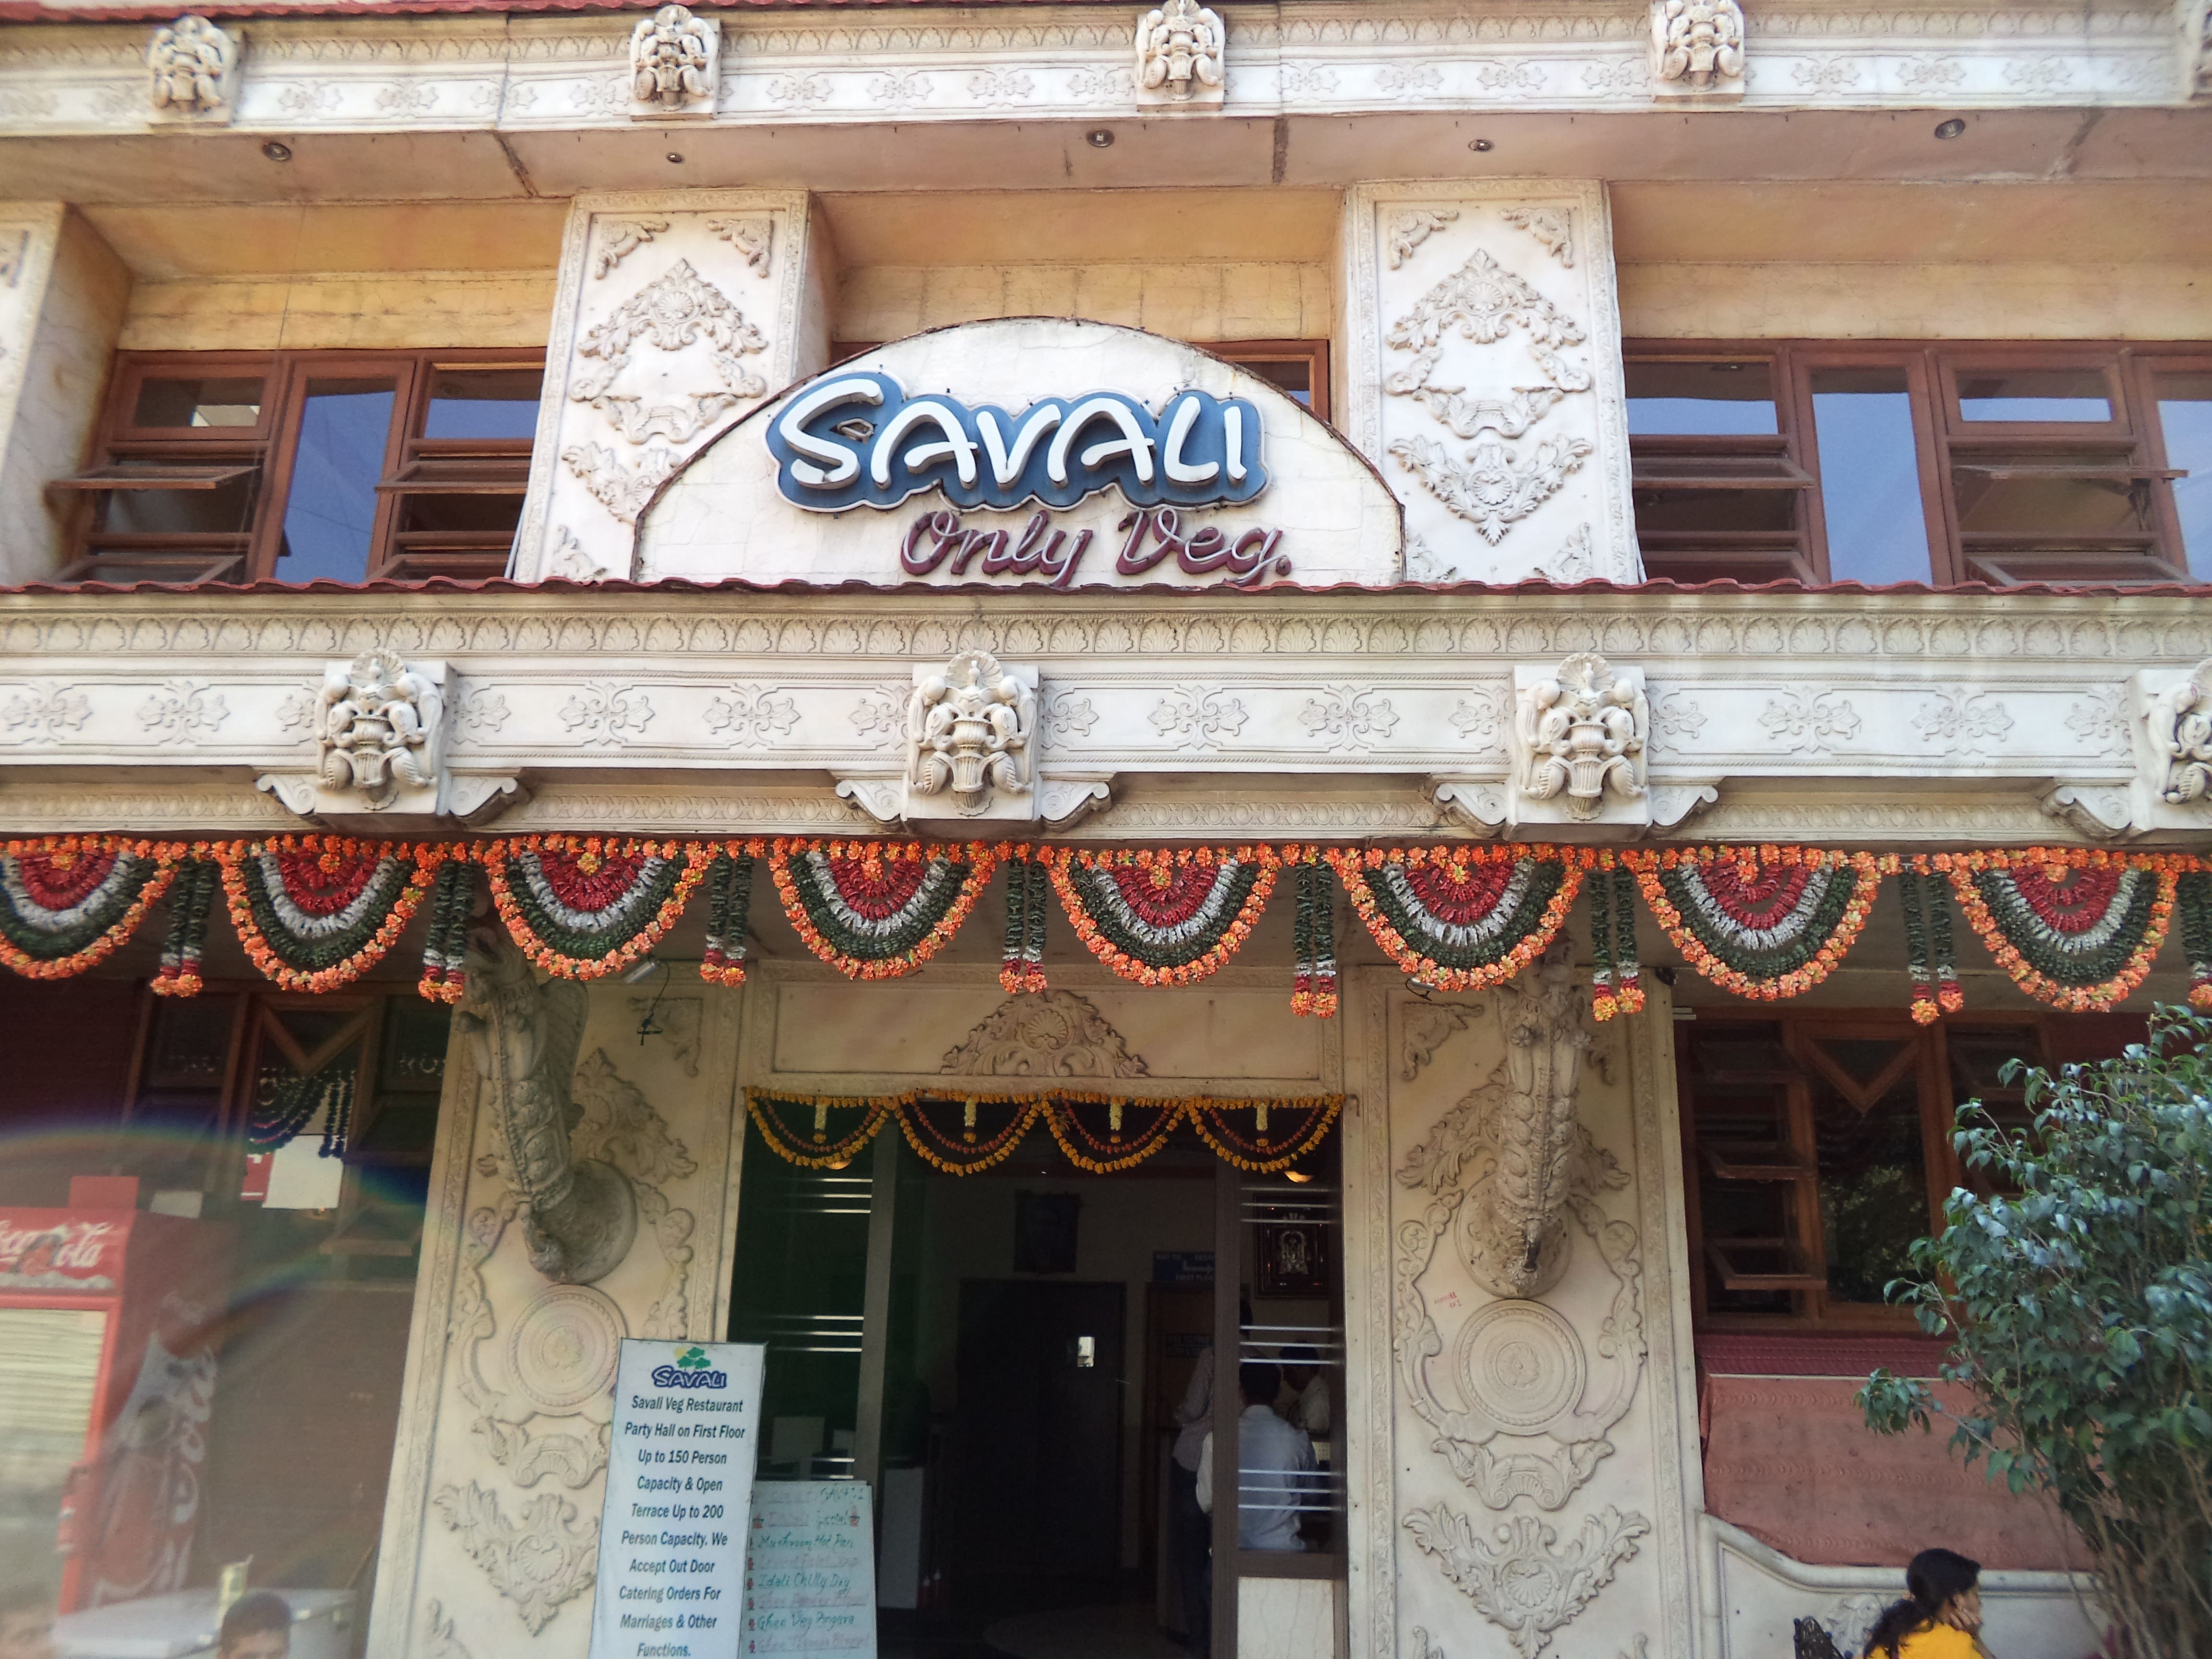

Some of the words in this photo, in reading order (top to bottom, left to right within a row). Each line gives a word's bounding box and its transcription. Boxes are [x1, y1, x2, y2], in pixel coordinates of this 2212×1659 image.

[778, 377, 1249, 491] SAVALI
[901, 509, 1094, 588] Only
[651, 1364, 727, 1389] SAVALI
[666, 1397, 685, 1413] Veg
[686, 1397, 744, 1412] Restaurant
[625, 1421, 652, 1439] Party
[655, 1422, 676, 1437] Hall
[678, 1427, 690, 1437] on
[693, 1424, 717, 1438] First
[719, 1425, 745, 1438] Floor
[638, 1449, 652, 1466] Up
[655, 1451, 665, 1463] to
[668, 1450, 689, 1464] 150
[691, 1451, 727, 1465] Person
[637, 1475, 683, 1493] Capacity
[685, 1477, 693, 1491] &
[697, 1477, 723, 1494] Open
[632, 1503, 669, 1517] Terrace
[672, 1503, 686, 1521] Up
[689, 1505, 699, 1518] to
[702, 1505, 724, 1518] 200
[621, 1530, 657, 1545] Person
[712, 1532, 728, 1546] We
[629, 1559, 666, 1575] Accept
[669, 1559, 687, 1573] Out
[689, 1559, 716, 1573] Door
[619, 1586, 665, 1603] Catering
[667, 1586, 701, 1600] Orders
[703, 1586, 721, 1600] For
[620, 1613, 673, 1632] Marriages
[675, 1614, 685, 1628] &
[687, 1614, 718, 1628] Other
[637, 1642, 691, 1657] Functions.
